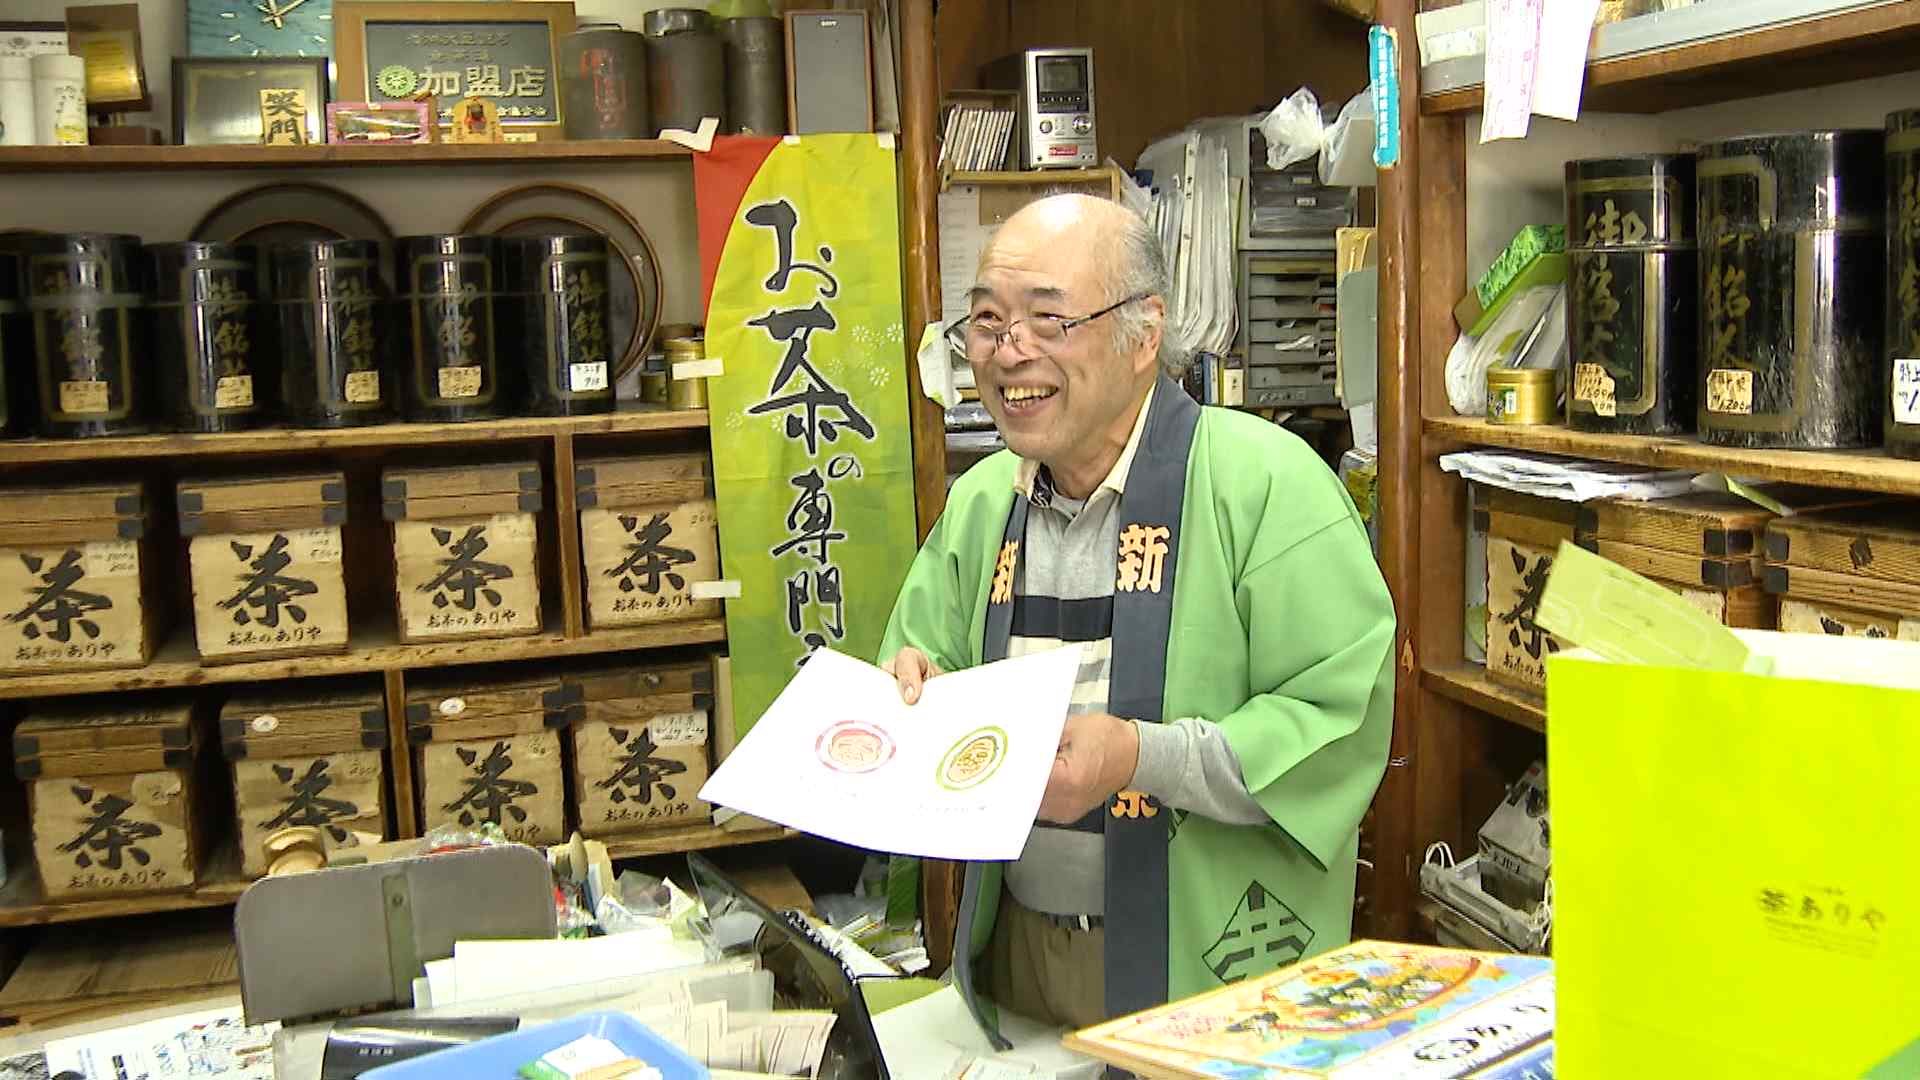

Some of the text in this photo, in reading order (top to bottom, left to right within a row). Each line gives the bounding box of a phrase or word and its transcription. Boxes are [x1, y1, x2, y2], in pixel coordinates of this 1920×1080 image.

[264, 91, 304, 145] 笑門
[418, 65, 546, 98] 加盟店
[215, 533, 319, 628] 茶
[416, 525, 513, 611] 茶
[602, 511, 697, 594] 茶
[1116, 523, 1171, 594] 新
[2, 549, 113, 643] 茶
[257, 758, 358, 846] 茶
[441, 740, 538, 828] 茶
[595, 727, 687, 805] 茶
[56, 784, 163, 870] 茶
